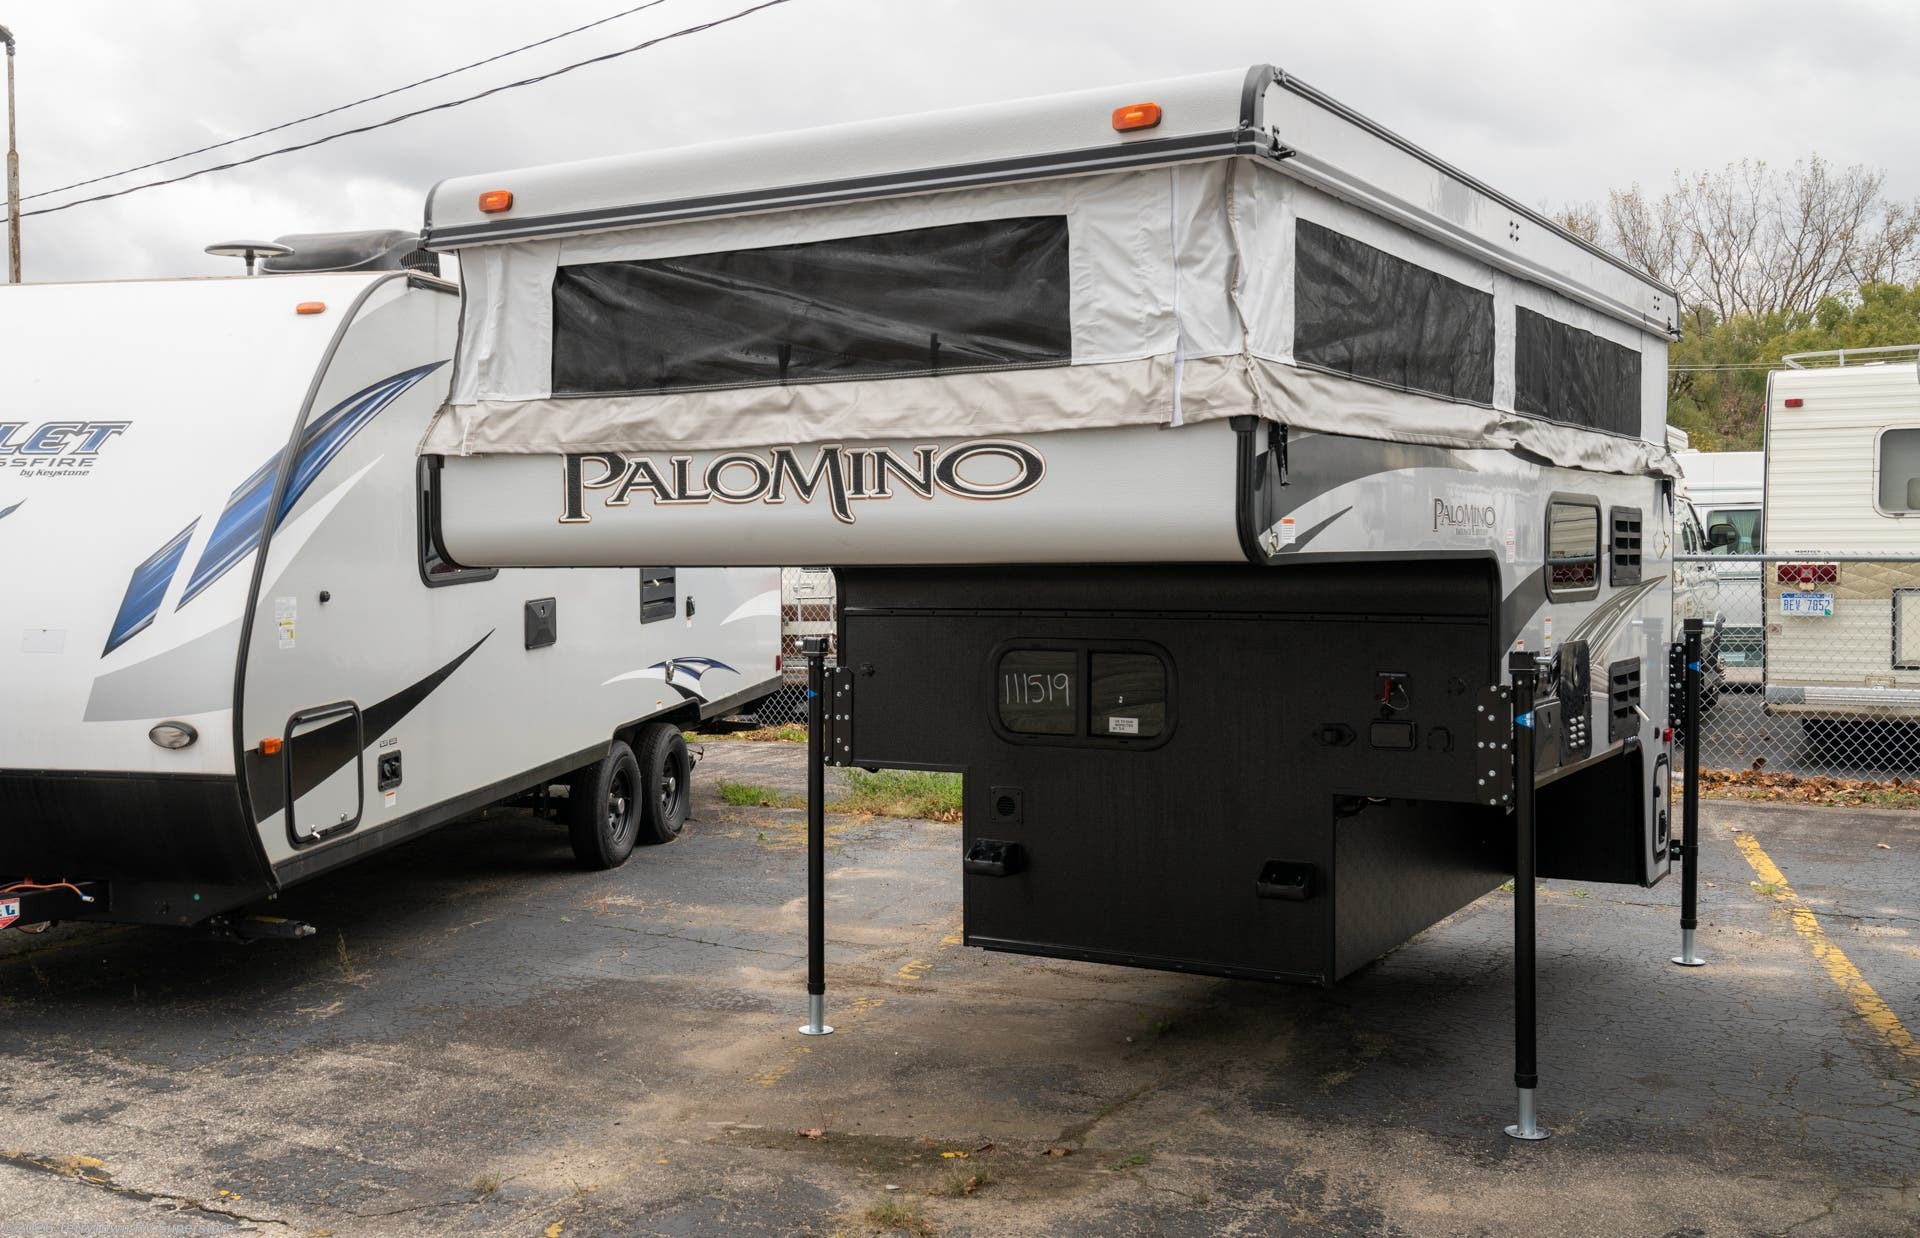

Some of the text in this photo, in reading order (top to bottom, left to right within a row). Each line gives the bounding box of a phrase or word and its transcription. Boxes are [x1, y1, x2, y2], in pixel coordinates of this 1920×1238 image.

[20, 469, 90, 478] by Keystone
[558, 437, 1048, 524] PALOMINO
[1432, 497, 1496, 535] PALOMINO
[1005, 672, 1070, 707] 111519
